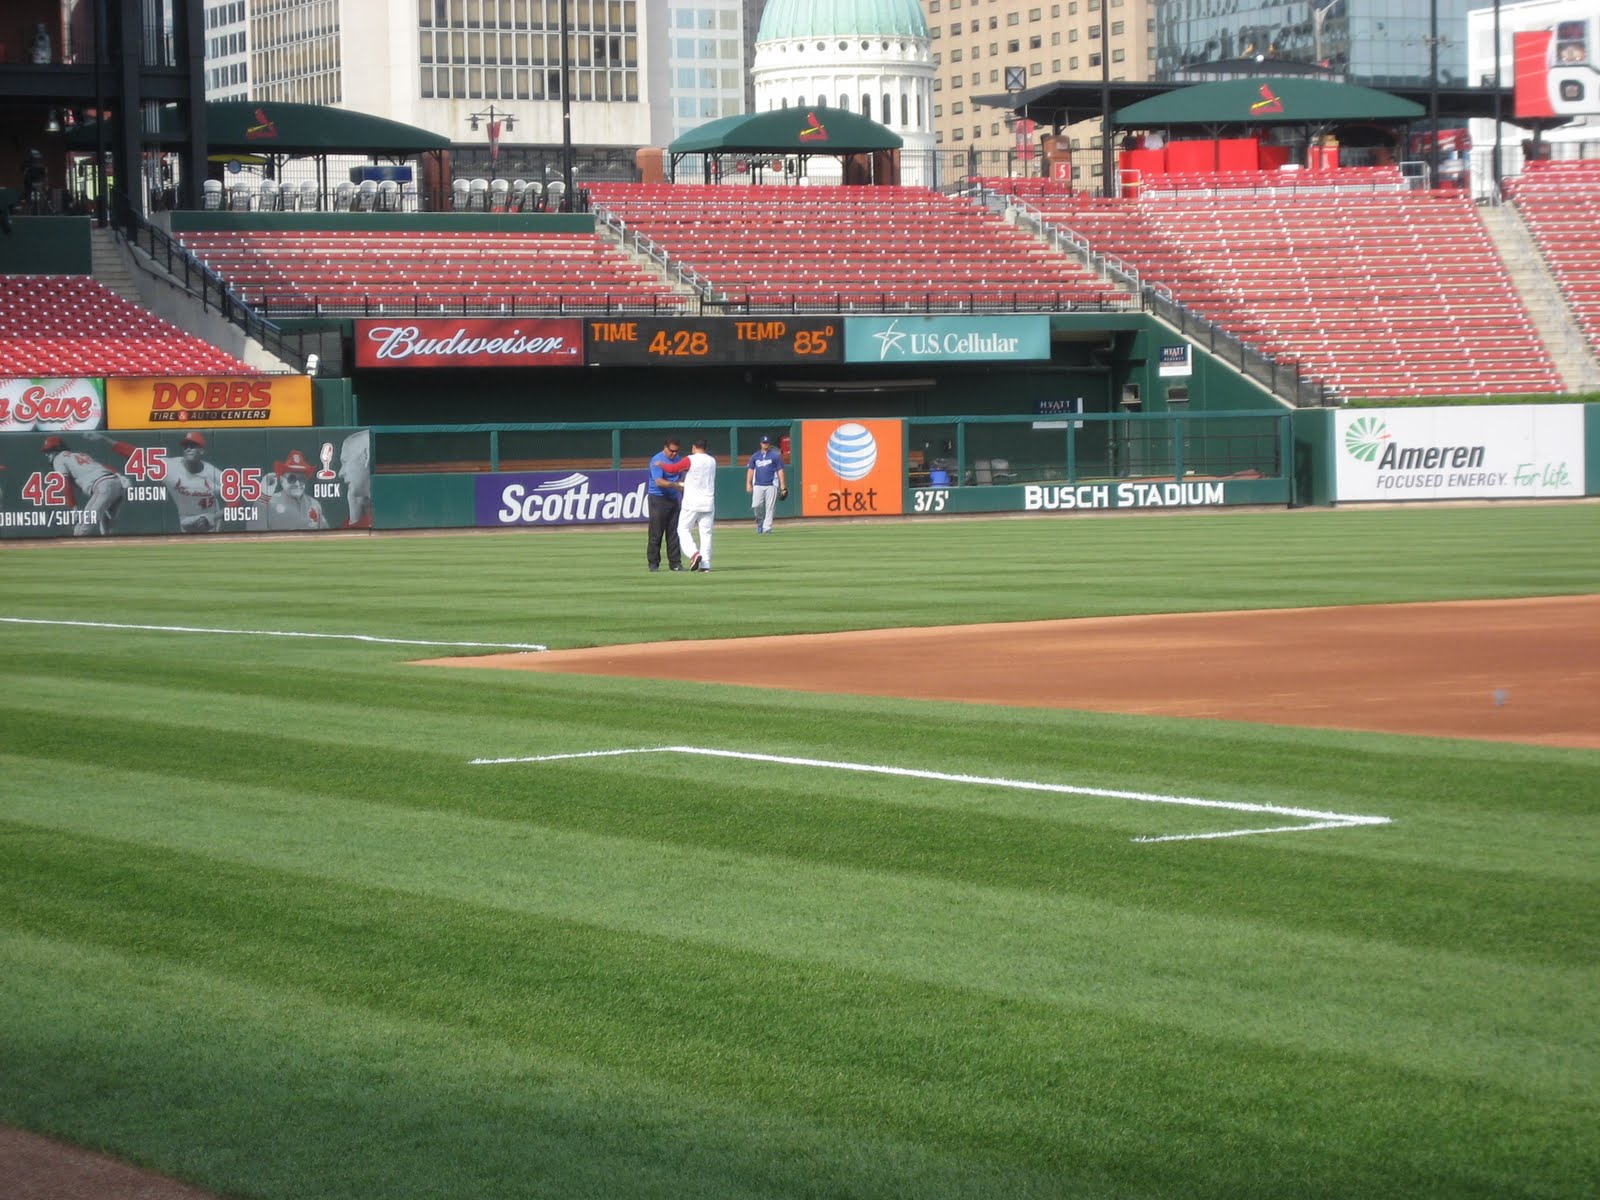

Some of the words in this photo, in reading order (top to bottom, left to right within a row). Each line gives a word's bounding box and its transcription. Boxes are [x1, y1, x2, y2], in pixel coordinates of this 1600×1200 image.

[1060, 164, 1066, 178] 5
[591, 322, 638, 342] TIME
[735, 321, 786, 340] TEMP
[368, 326, 564, 360] Budweiser
[648, 330, 709, 356] 4:28
[911, 333, 942, 355] U.S.
[943, 332, 1018, 353] Cellular
[1163, 347, 1184, 357] HYATT
[13, 385, 93, 422] Save
[152, 382, 272, 409] DOBBS
[1040, 400, 1070, 409] HYATT
[153, 412, 175, 420] TIRE
[191, 411, 218, 420] AUTO
[220, 410, 268, 419] CENTERS
[124, 447, 168, 482] 45
[1378, 442, 1486, 470] Ameren
[220, 468, 262, 502] 85
[1376, 474, 1443, 489] FOCUSED
[1513, 463, 1543, 487] For
[21, 471, 66, 506] 42
[127, 486, 166, 501] GIBSON
[313, 483, 340, 498] BUCK
[827, 488, 877, 512] at&t
[1024, 485, 1109, 510] BUSCH
[1117, 482, 1225, 507] STADIUM
[223, 507, 258, 522] BUSCH
